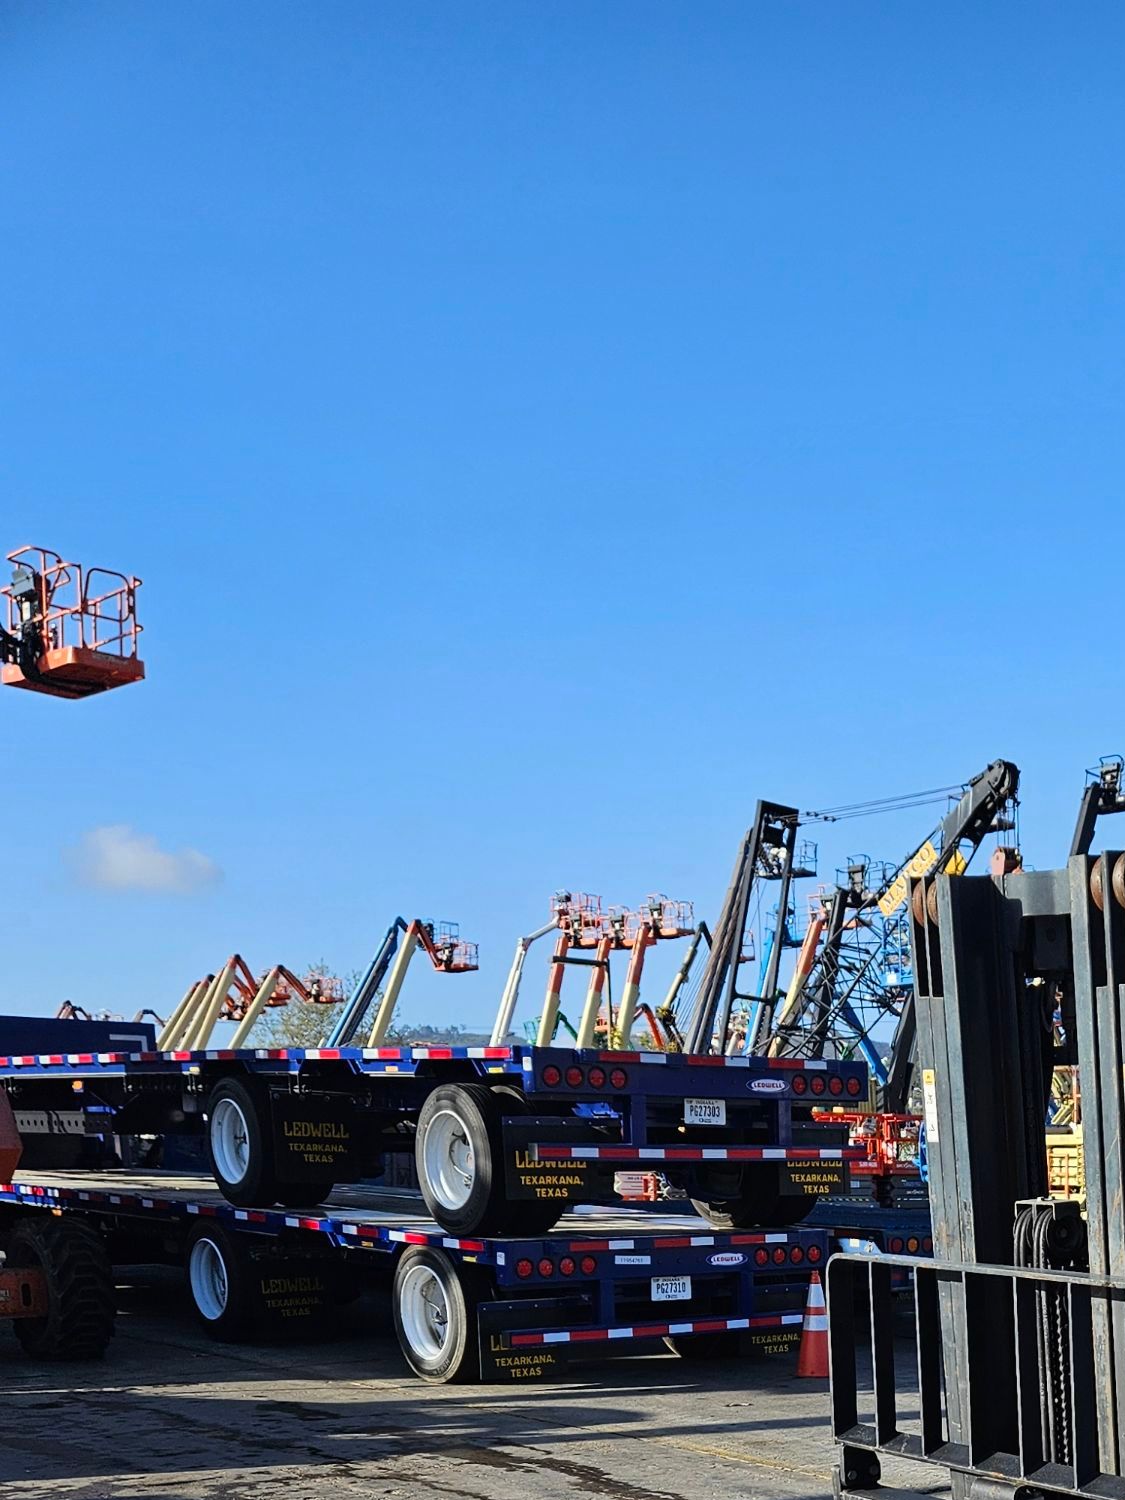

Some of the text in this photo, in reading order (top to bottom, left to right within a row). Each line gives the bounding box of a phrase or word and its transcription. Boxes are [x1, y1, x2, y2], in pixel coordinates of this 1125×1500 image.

[689, 1105, 721, 1117] PG27303
[283, 1120, 350, 1139] LEDWELL
[288, 1143, 348, 1153] TEXARKANA,
[303, 1153, 334, 1163] TEXAS
[519, 1175, 584, 1186] TEXARKANA,
[790, 1173, 841, 1183] TEXARKANA,
[535, 1187, 569, 1198] TEXAS
[803, 1184, 830, 1194] TEXAS
[656, 1282, 686, 1294] PG27310
[752, 1333, 801, 1345] TEXARKANA,
[763, 1344, 789, 1354] TEXAS
[495, 1354, 556, 1367] TEXARKANA,
[510, 1366, 542, 1378] TEXAS
